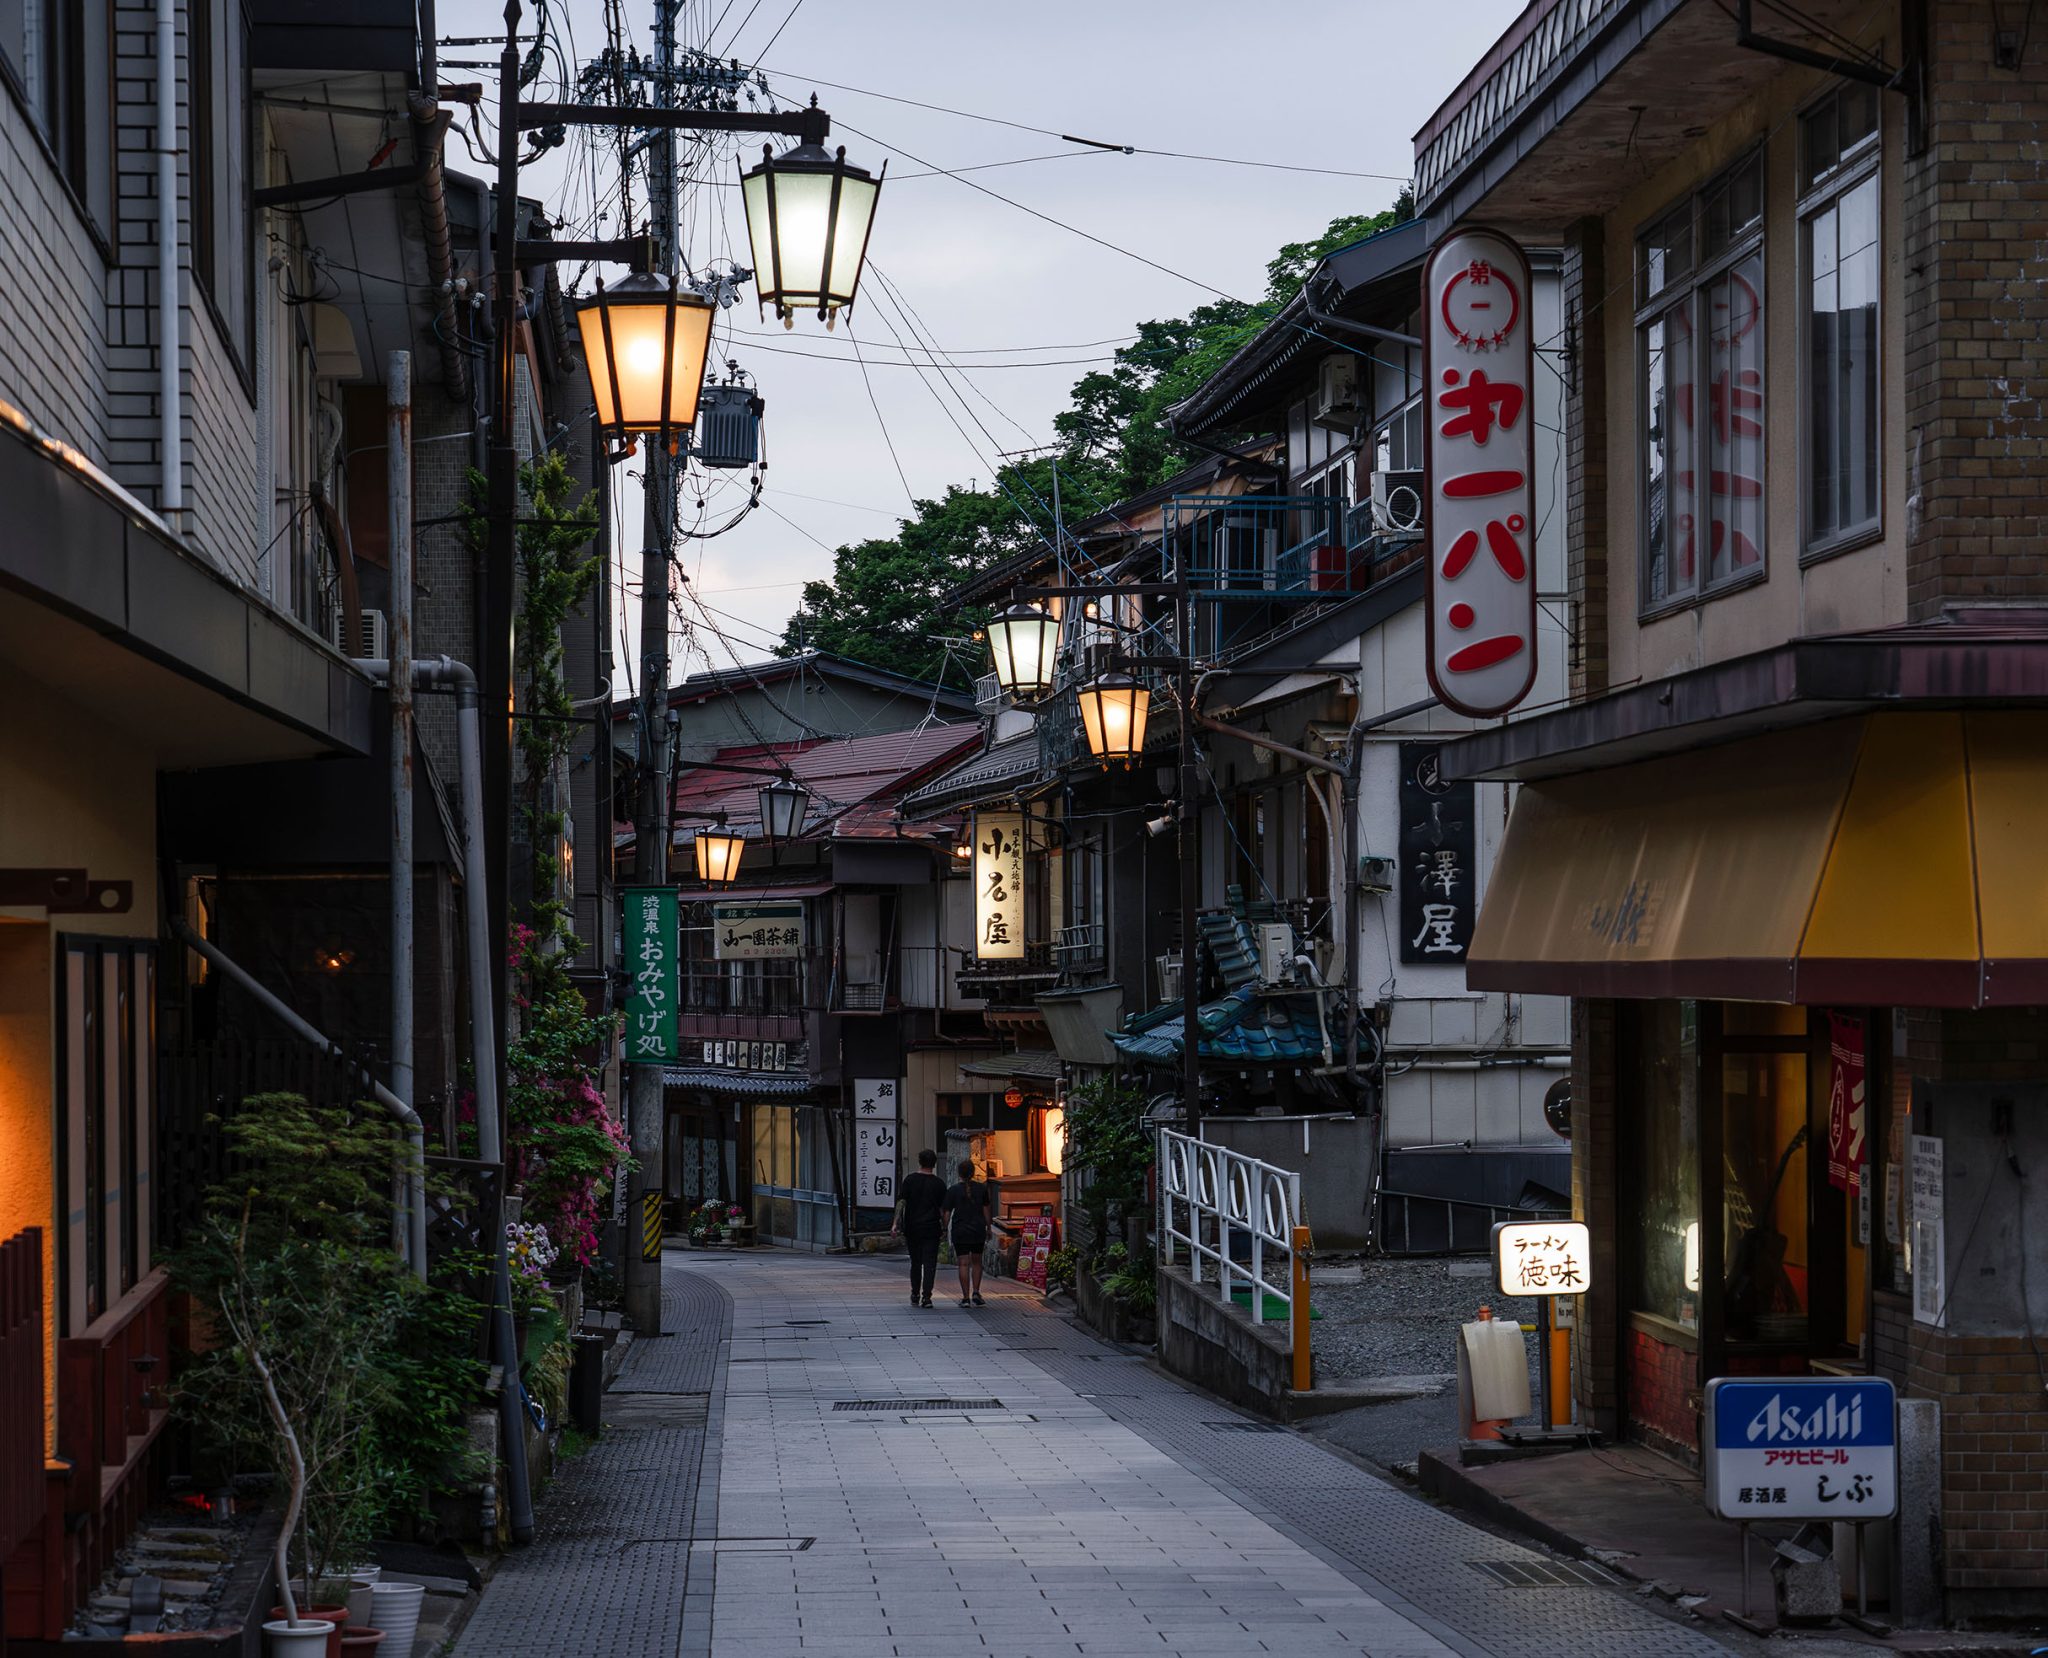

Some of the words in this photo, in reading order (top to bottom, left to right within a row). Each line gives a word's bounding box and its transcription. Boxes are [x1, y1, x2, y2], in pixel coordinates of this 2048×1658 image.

[1410, 801, 1465, 954] 小澤屋
[642, 895, 660, 934] 渋温泉
[636, 937, 667, 1057] おみやげ処
[874, 1127, 894, 1197] 山一園
[1514, 1235, 1569, 1251] ラーメン
[1517, 1254, 1584, 1288] 徳味
[1746, 1392, 1862, 1442] Asahi
[1764, 1449, 1849, 1466] アサヒビール
[1738, 1487, 1787, 1504] 居酒屋
[1818, 1474, 1874, 1503] しぶ
